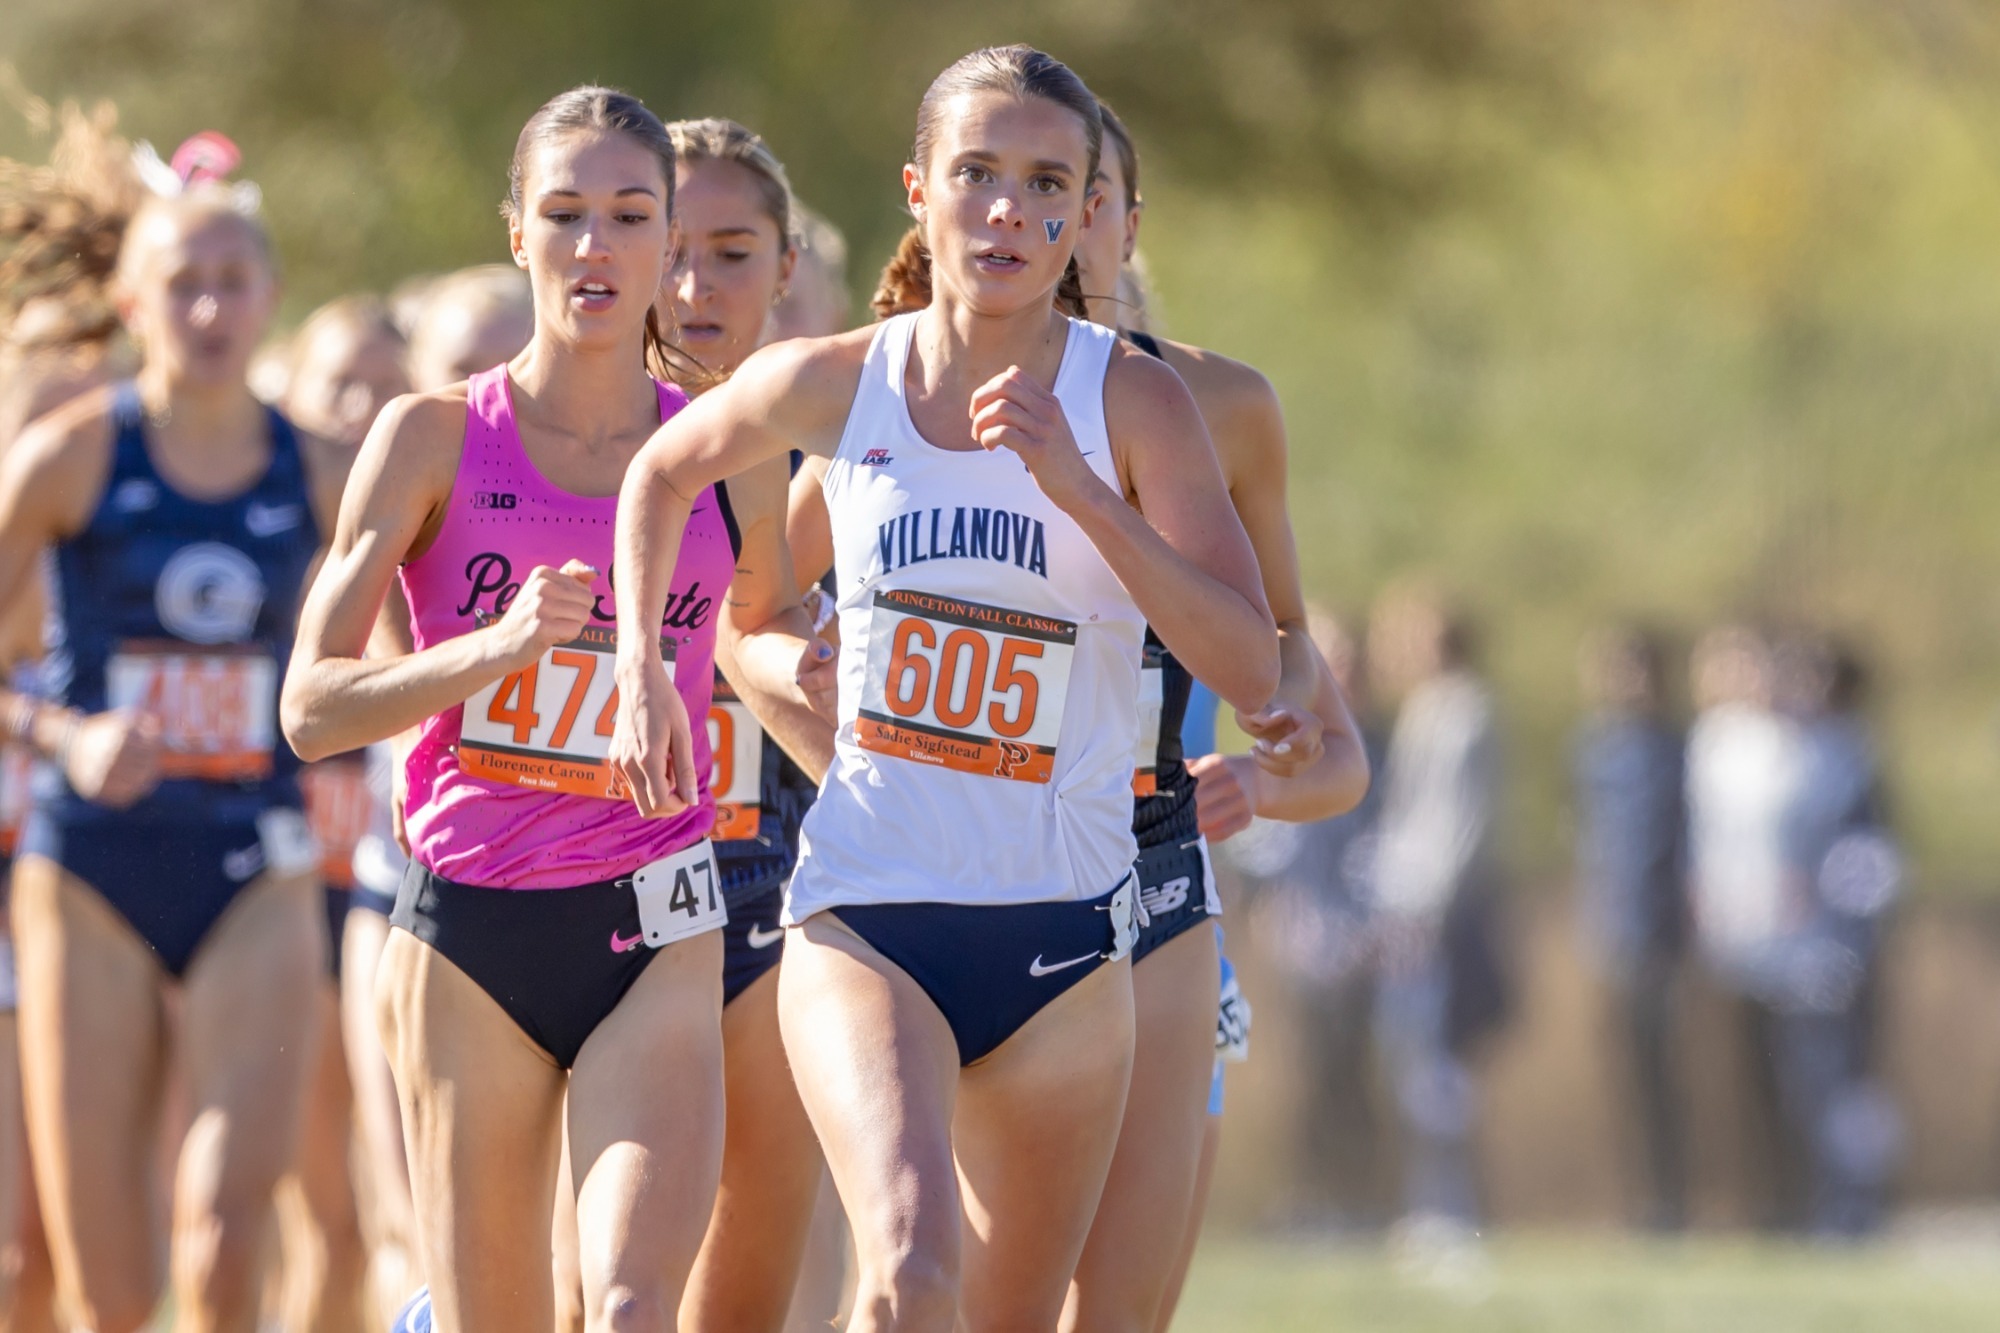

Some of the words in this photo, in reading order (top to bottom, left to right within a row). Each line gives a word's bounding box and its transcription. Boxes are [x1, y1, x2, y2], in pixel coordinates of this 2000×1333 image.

[1043, 219, 1066, 244] V
[861, 456, 894, 465] EAST
[878, 506, 1048, 580] VILLANOVA
[457, 551, 521, 617] Pe
[887, 590, 967, 616] PRINCETON
[968, 606, 1003, 625] FALL
[1005, 613, 1064, 635] CLASSIC
[577, 628, 606, 644] ALL
[884, 617, 1045, 739] 605
[875, 725, 912, 746] Sadie
[914, 734, 982, 761] Sigfstead
[909, 749, 944, 764] Villanova
[993, 740, 1031, 779] P
[480, 752, 545, 775] Florence
[548, 762, 596, 781] Caron
[518, 775, 538, 786] Penn
[538, 777, 558, 789] State
[669, 856, 721, 918] 47
